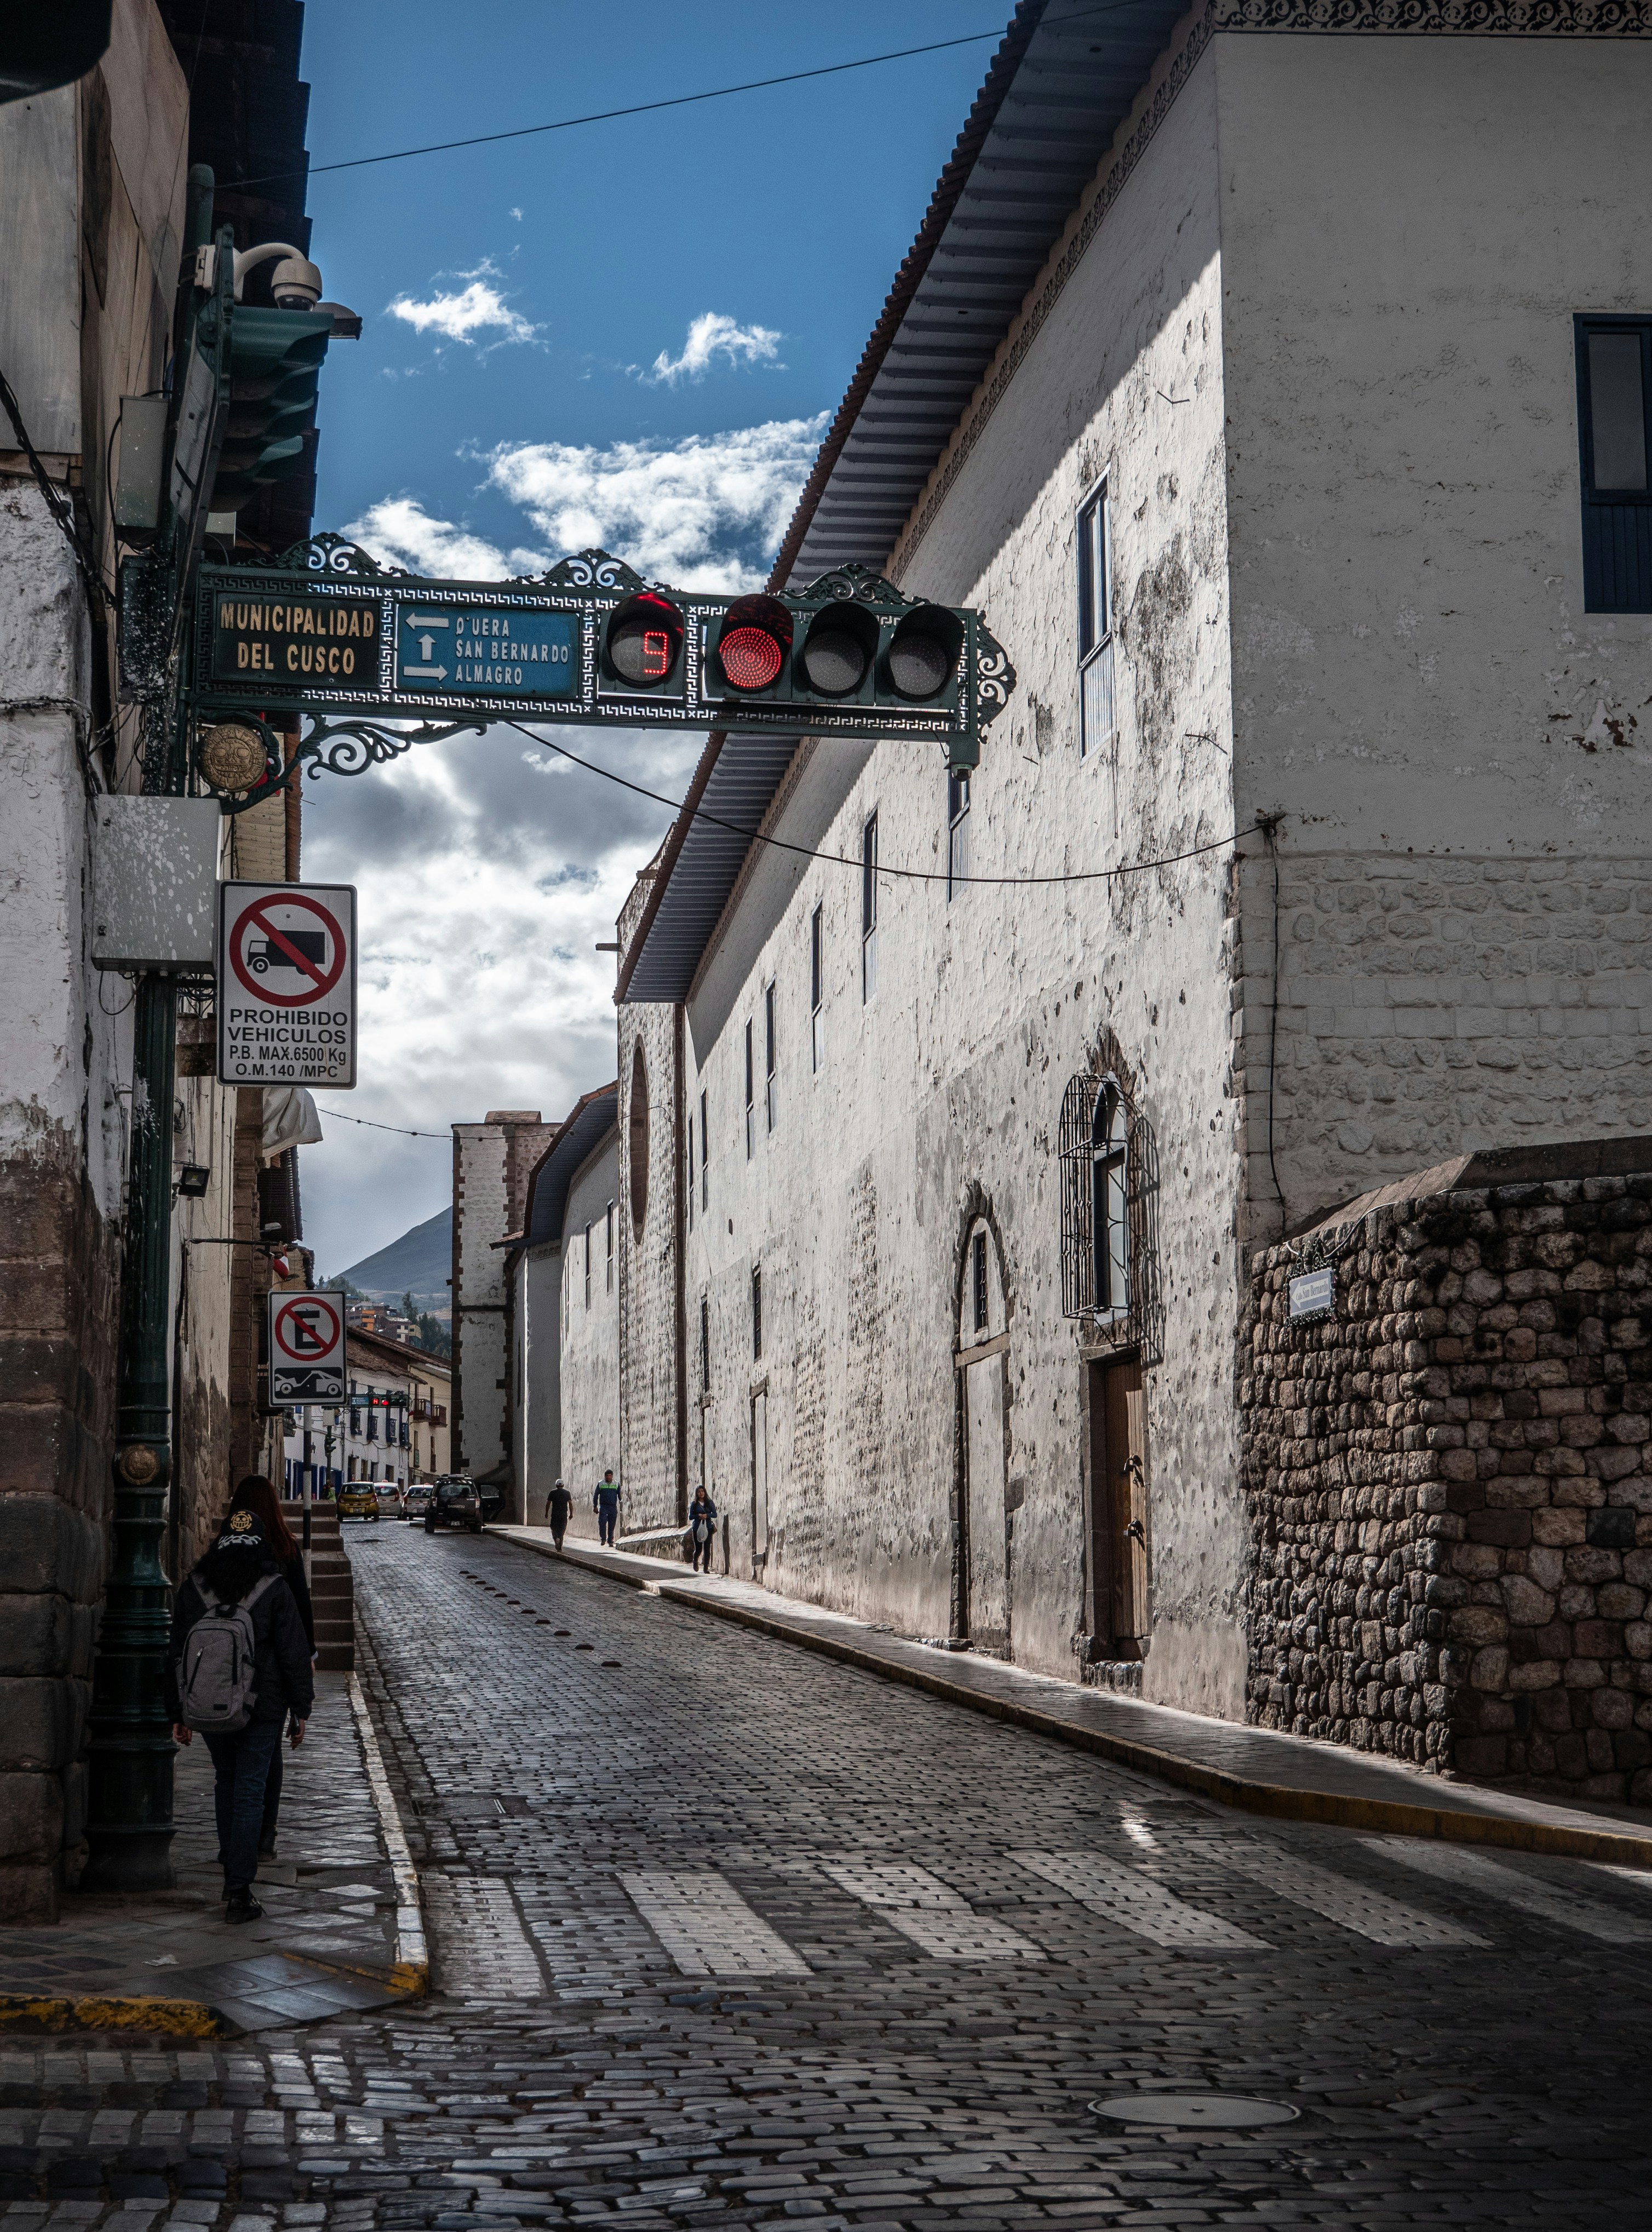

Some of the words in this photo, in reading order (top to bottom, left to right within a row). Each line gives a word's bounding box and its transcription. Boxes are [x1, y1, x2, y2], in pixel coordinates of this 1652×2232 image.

[221, 603, 374, 638] MUNICIPALIDAD
[238, 642, 274, 670] DEL
[287, 644, 355, 675] CUSCO
[456, 639, 483, 659] SAN
[491, 642, 569, 663] BERNARDO
[644, 631, 668, 674] 9
[455, 665, 522, 685] ALMAGRO
[230, 1009, 348, 1026] PROHIBIDO
[227, 1027, 346, 1044] VEHICULOS
[230, 1045, 254, 1060] P.B.
[329, 1048, 346, 1066] Kg
[1310, 1281, 1328, 1297] Bernardo
[294, 1310, 321, 1349] E
